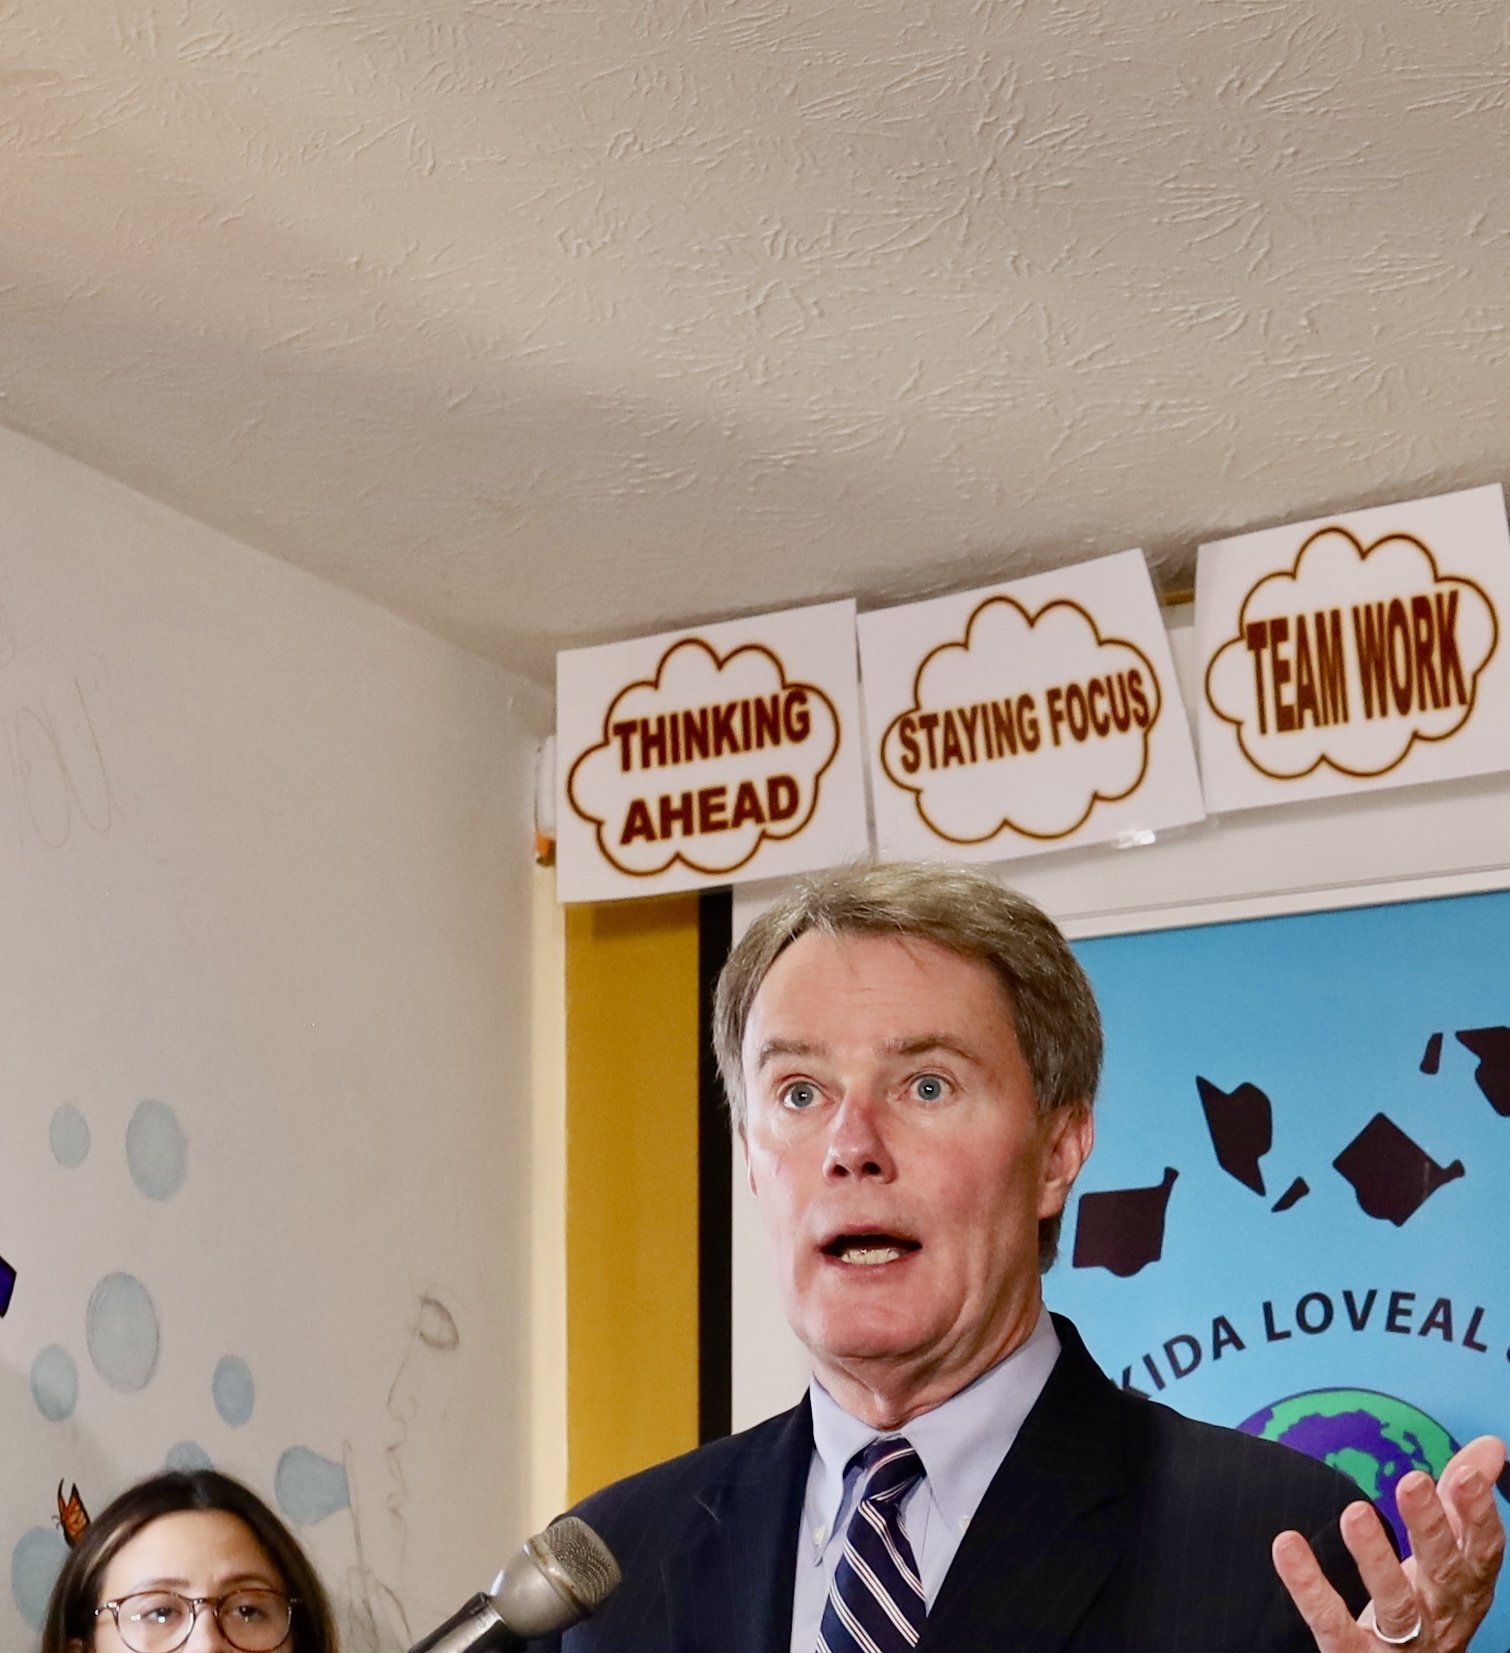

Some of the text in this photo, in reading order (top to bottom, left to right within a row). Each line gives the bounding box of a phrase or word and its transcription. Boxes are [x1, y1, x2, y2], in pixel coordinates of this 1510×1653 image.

[1246, 590, 1468, 735] TEAM WORK
[614, 687, 811, 773] THINKING
[899, 668, 1150, 774] STAYING FOCUS
[620, 773, 801, 845] AHEAD
[1263, 1289, 1488, 1352] LOVEAL
